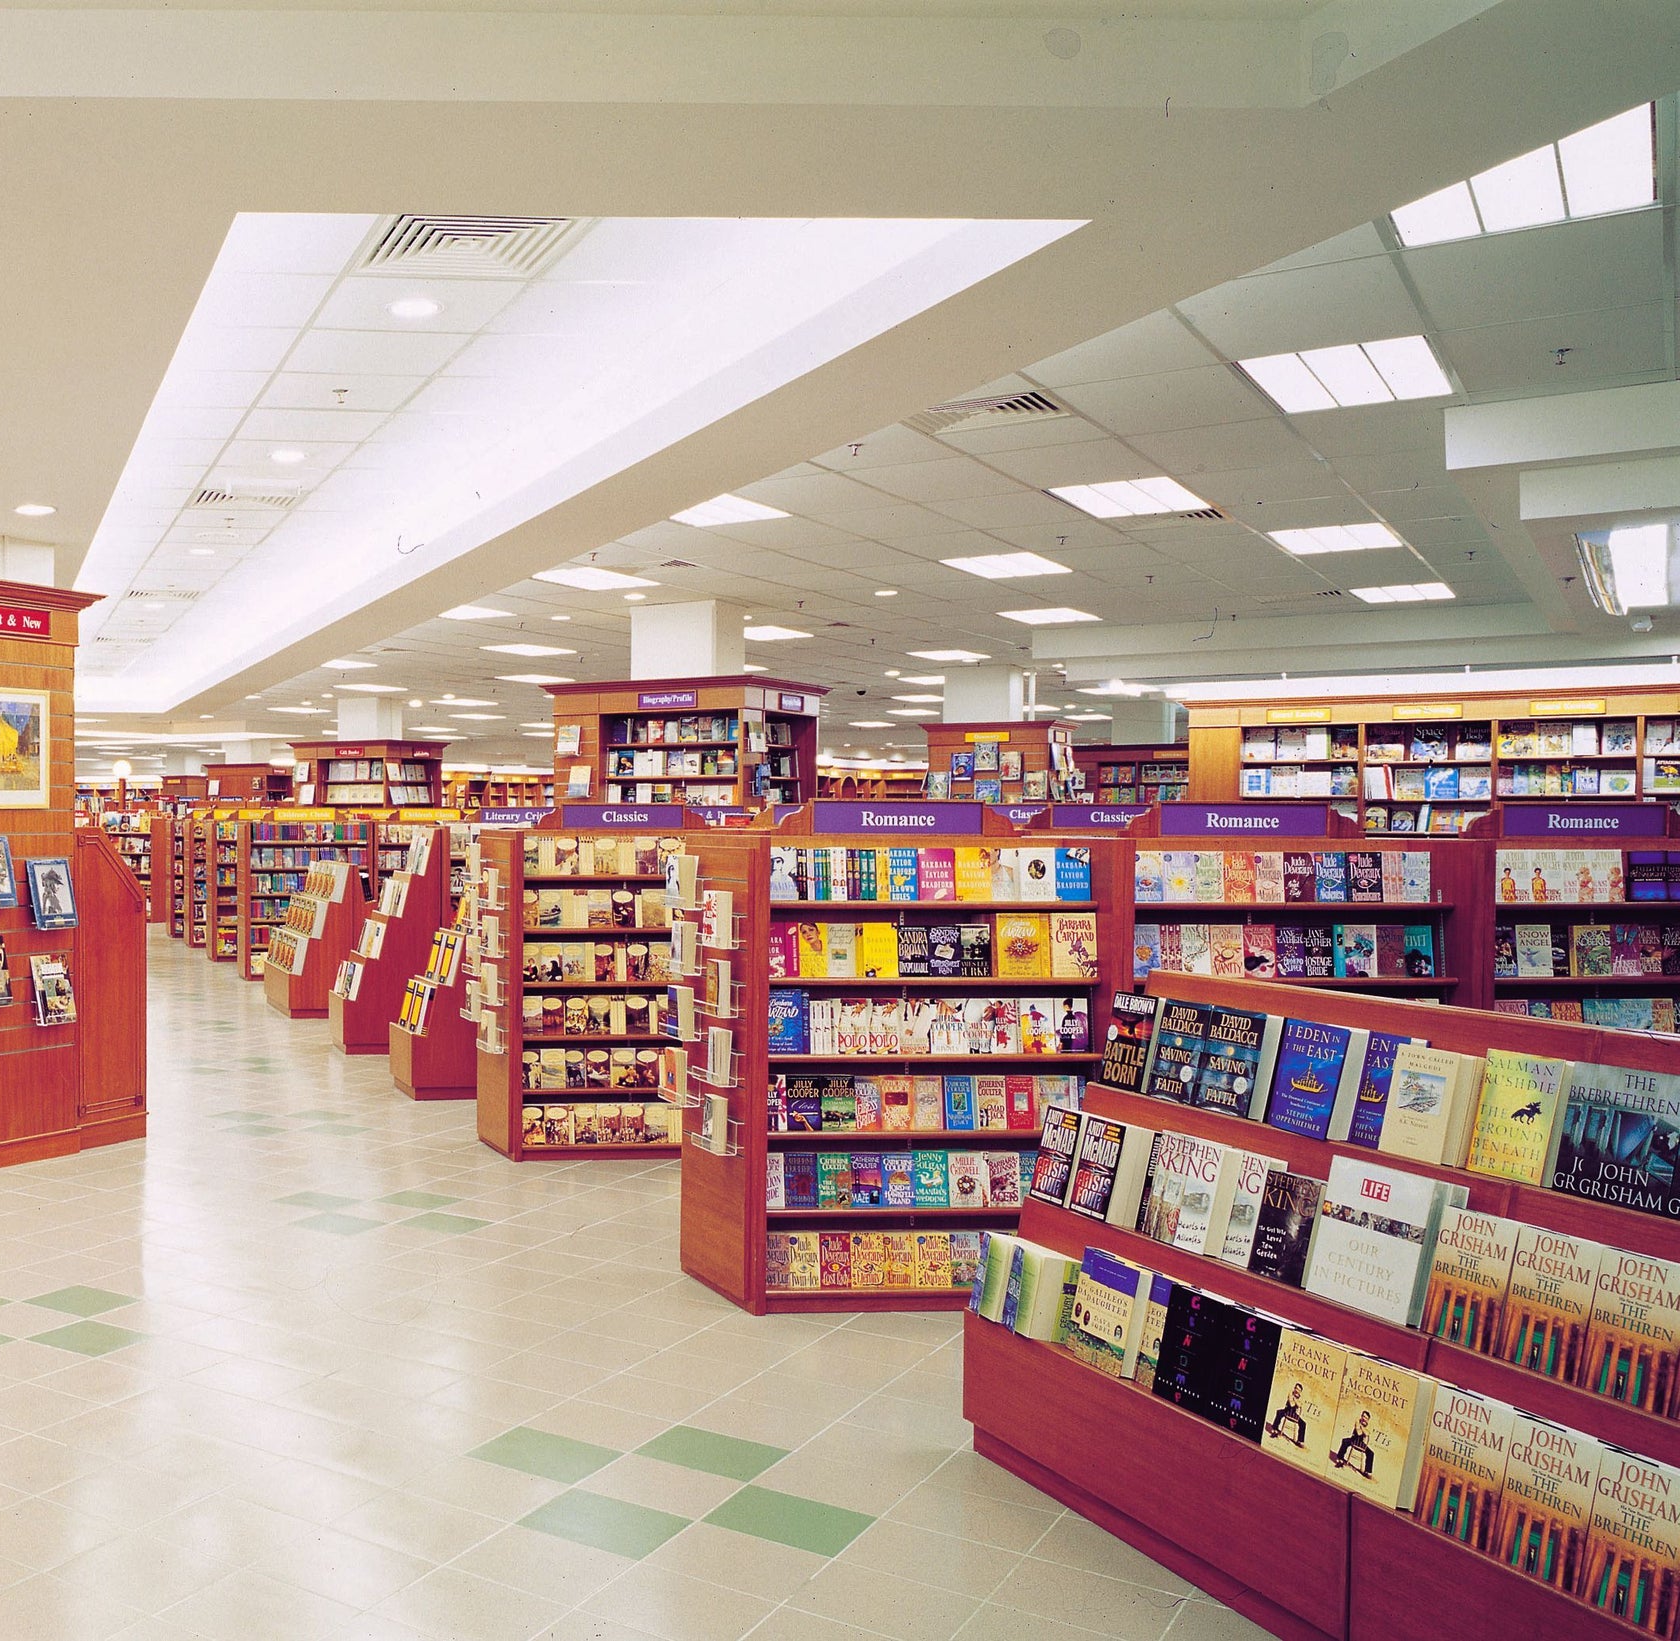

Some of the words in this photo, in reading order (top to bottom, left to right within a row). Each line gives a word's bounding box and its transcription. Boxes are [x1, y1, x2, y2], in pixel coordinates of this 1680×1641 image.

[7, 615, 16, 626] &
[23, 617, 41, 629] New
[1415, 726, 1444, 738] Space
[485, 811, 520, 822] Literary
[602, 811, 648, 823] Classics
[861, 811, 936, 827] Romance
[1206, 812, 1280, 829] Romance
[1548, 813, 1619, 829] Romance
[1358, 853, 1373, 867] Jude
[921, 881, 954, 889] BRADFORD
[925, 871, 949, 879] TAYLOR
[1056, 881, 1089, 889] BRADFORD
[1060, 871, 1084, 879] TAYLOR
[899, 931, 928, 944] SANDRA
[1519, 931, 1550, 939] SNOW
[1520, 939, 1550, 947] ANGEL
[899, 943, 928, 956] BROWN
[1213, 962, 1243, 975] VANITY
[1308, 966, 1328, 976] BRIDE
[1113, 995, 1130, 1009] DALE
[1129, 998, 1155, 1014] BROWN
[1170, 1006, 1198, 1021] DAVID
[1161, 1017, 1204, 1036] BALDACCI
[1220, 1013, 1251, 1030] DAVID
[838, 1032, 867, 1048] POLO
[870, 1032, 899, 1048] POLO
[1210, 1025, 1258, 1046] BALDACCI
[1295, 1026, 1331, 1043] EDEN
[1332, 1034, 1341, 1043] IN
[1104, 1041, 1145, 1067] BATTLE
[1159, 1046, 1191, 1063] SAVING
[1292, 1043, 1305, 1053] THE
[1306, 1045, 1337, 1062] EAST
[1103, 1062, 1137, 1085] BORN
[1209, 1055, 1246, 1075] SAVING
[1487, 1055, 1555, 1077] SALMAN
[793, 1080, 814, 1090] JILLY
[822, 1088, 855, 1097] COOPER
[828, 1080, 849, 1089] JILLY
[1156, 1077, 1183, 1095] FAITH
[1484, 1073, 1556, 1095] RUSHDIE
[1624, 1073, 1657, 1092] THE
[787, 1088, 820, 1098] COOPER
[1205, 1089, 1238, 1107] FAITH
[1595, 1087, 1680, 1115] BRETHREN
[1047, 1108, 1065, 1125] ANDY
[1286, 1108, 1314, 1122] STEPHEN
[1480, 1103, 1510, 1119] THE
[1087, 1120, 1107, 1138] ANDY
[1275, 1114, 1321, 1132] OPPENHEIMER
[1475, 1122, 1543, 1143] GROUND
[1040, 1123, 1077, 1155] McNAB
[1169, 1135, 1221, 1162] STEPHEN
[1081, 1134, 1120, 1169] McNAB
[1473, 1138, 1540, 1161] BENEATH
[1035, 1156, 1069, 1181] CRISIS
[1166, 1149, 1217, 1183] KING
[1469, 1153, 1497, 1170] HER
[1502, 1161, 1537, 1179] FEET
[1596, 1163, 1649, 1187] JOHN
[1035, 1173, 1062, 1196] FOUR
[1076, 1169, 1111, 1194] CRISIS
[1266, 1171, 1317, 1199] STEPHEN
[1362, 1180, 1390, 1201] LIFE
[1076, 1187, 1102, 1210] FOUR
[1263, 1187, 1314, 1218] KING
[1579, 1179, 1663, 1211] GRISHAM
[1456, 1213, 1497, 1236] JOHN
[1348, 1238, 1380, 1257] OUR
[1439, 1228, 1508, 1261] GRISHAM
[1533, 1234, 1580, 1260] JOHN
[1328, 1250, 1394, 1283] CENTURY
[1457, 1254, 1479, 1271] THE
[1516, 1250, 1592, 1285] GRISHAM
[1617, 1256, 1669, 1284] JOHN
[1435, 1260, 1500, 1289] BRETHREN
[1333, 1269, 1401, 1304] PICTURES
[1536, 1277, 1561, 1295] THE
[1086, 1295, 1128, 1317] DAUGHTER
[1512, 1283, 1584, 1315] BRETHREN
[1620, 1302, 1649, 1321] THE
[1594, 1308, 1674, 1343] BRETHREN
[1292, 1342, 1330, 1365] FRANK
[1282, 1353, 1338, 1382] McCOURT
[1359, 1367, 1401, 1392] FRANK
[1347, 1378, 1408, 1409] McCOURT
[1304, 1400, 1321, 1417] 'Tis
[1449, 1395, 1492, 1425] JOHN
[1372, 1428, 1391, 1447] 'Tis
[1432, 1410, 1505, 1452] GRISHAM
[1451, 1440, 1475, 1460] THE
[1528, 1426, 1578, 1459] JOHN
[1428, 1444, 1497, 1482] BRETHREN
[1510, 1442, 1591, 1488] GRISHAM
[1532, 1473, 1559, 1494] THE
[1618, 1461, 1672, 1496] JOHN
[1506, 1477, 1583, 1520] BRETHREN
[1621, 1511, 1651, 1533] THE
[1594, 1513, 1678, 1560] BRETHREN
